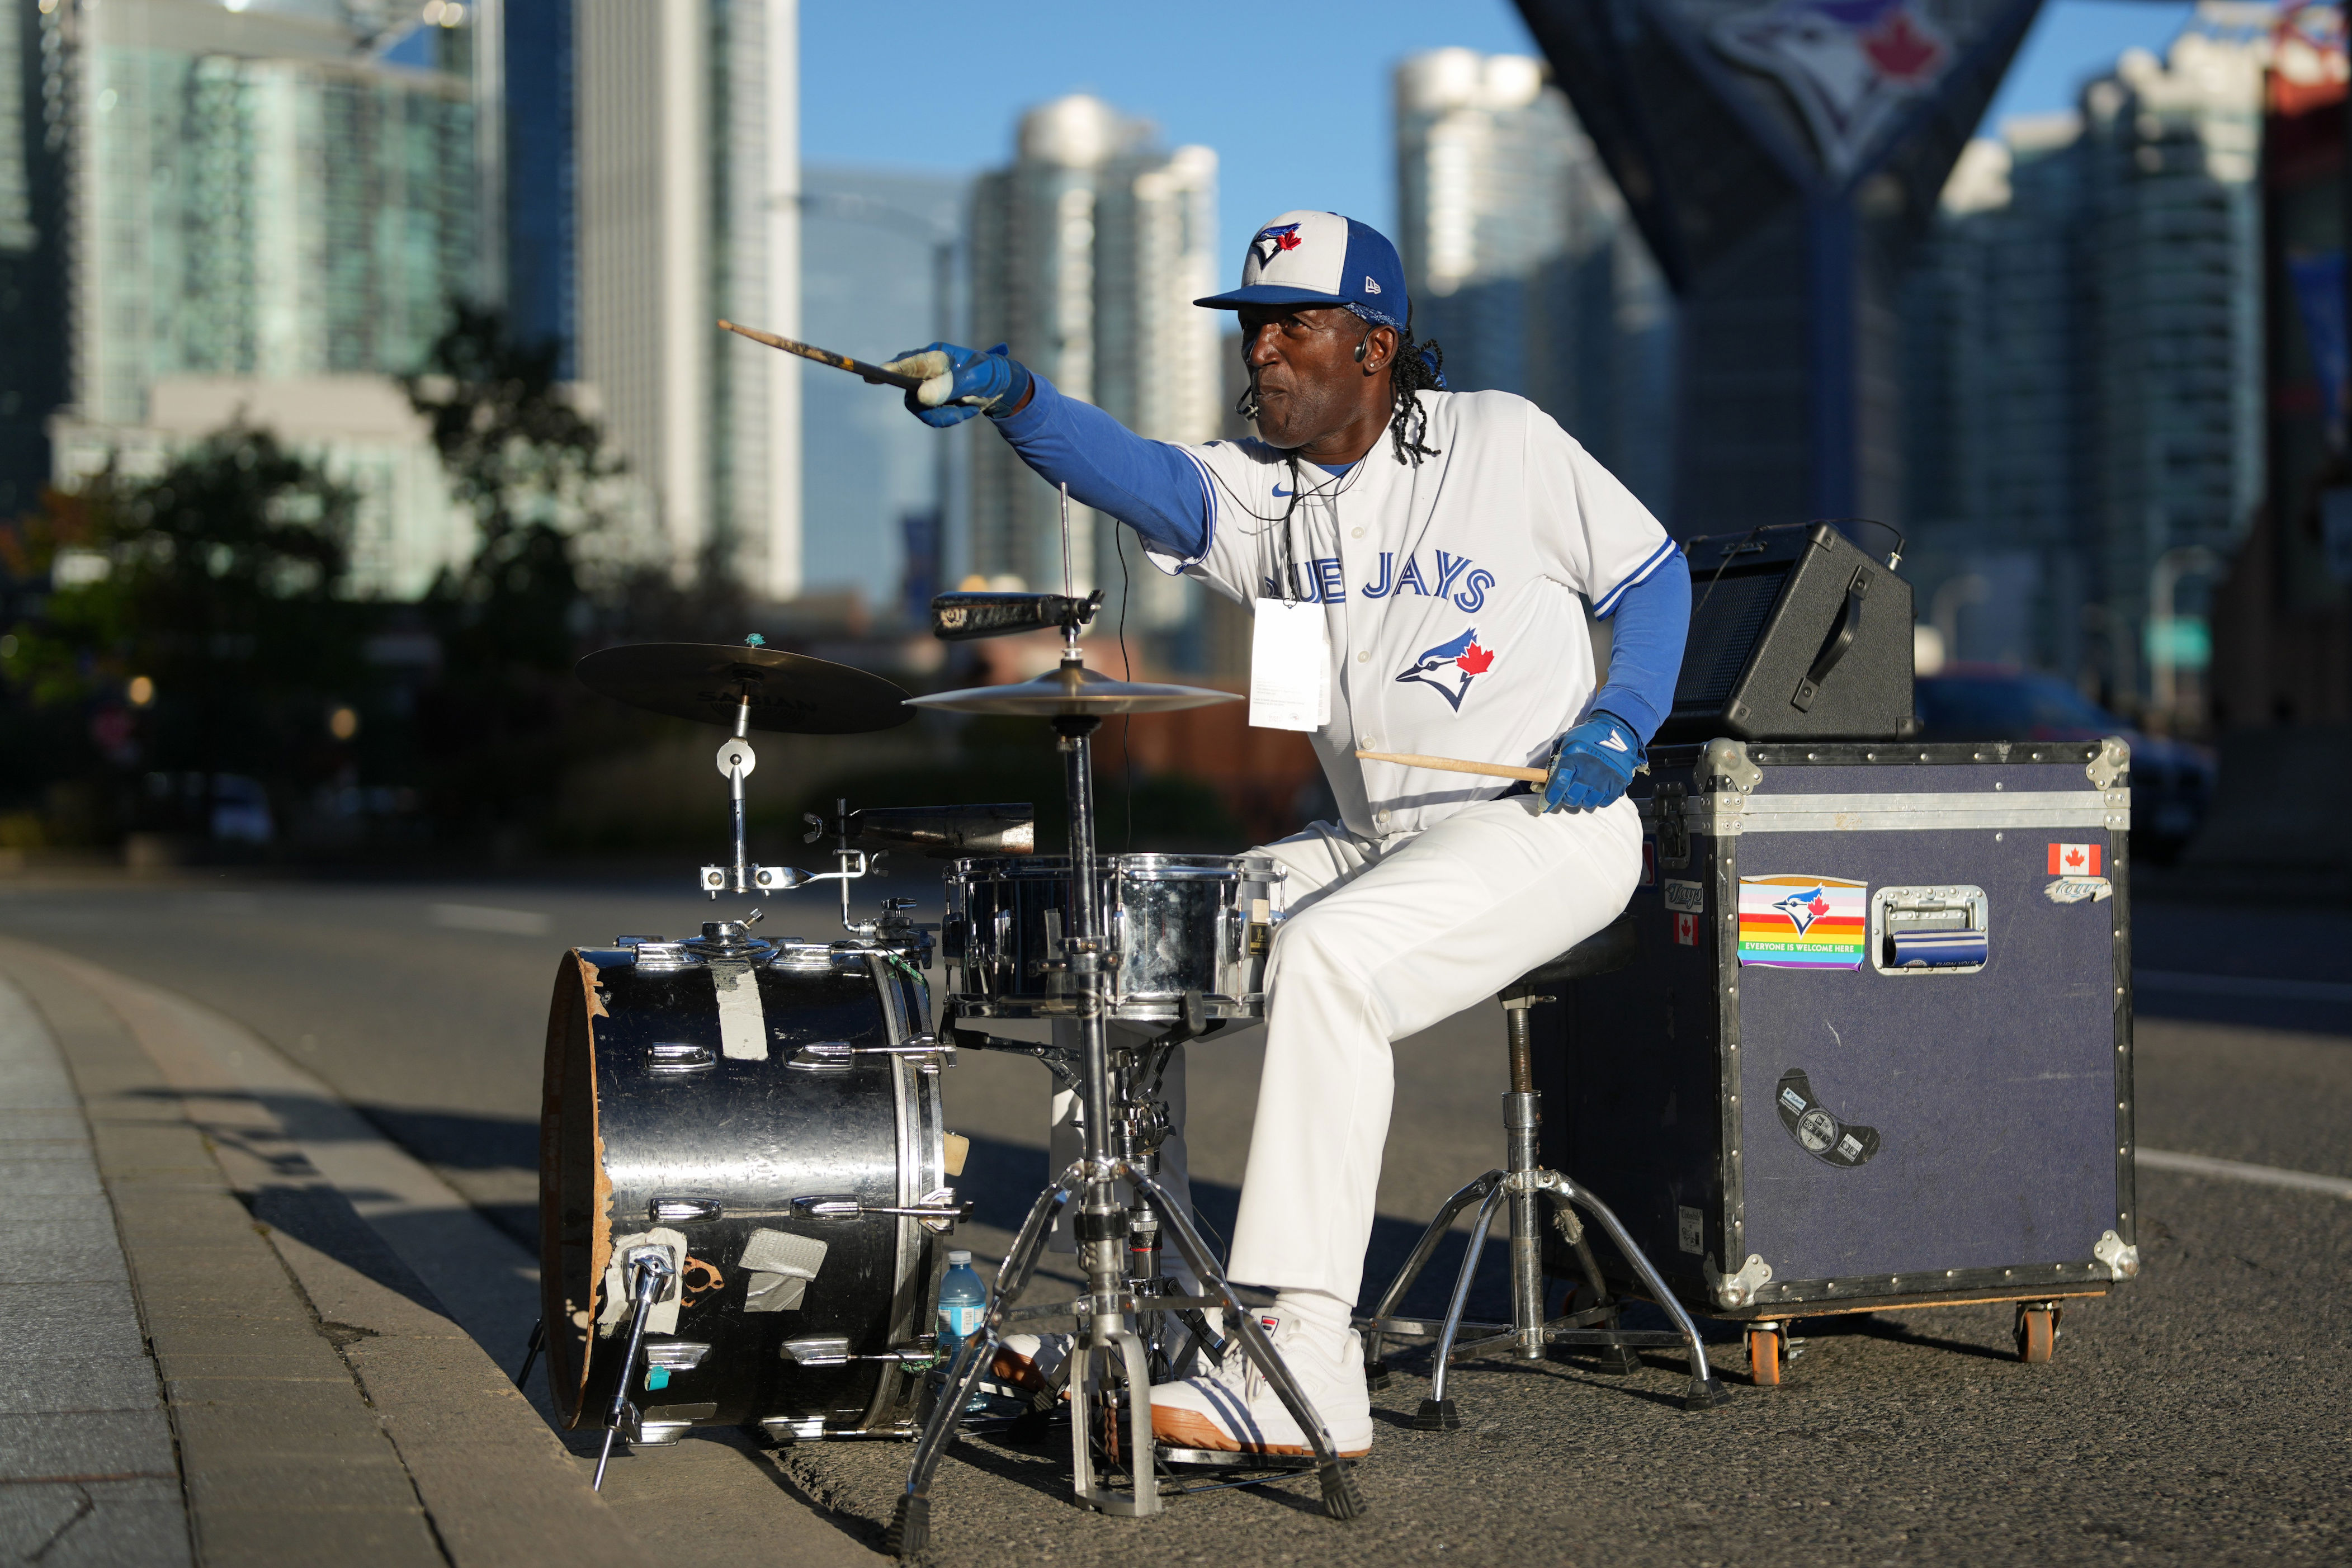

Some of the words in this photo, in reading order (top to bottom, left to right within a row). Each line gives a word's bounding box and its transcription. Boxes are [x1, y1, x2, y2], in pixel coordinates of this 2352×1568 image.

[1361, 549, 1496, 613] JAYS
[1668, 882, 1703, 910] Jays
[1745, 942, 1785, 951] EVERYONE
[1796, 943, 1834, 952] WELCOME
